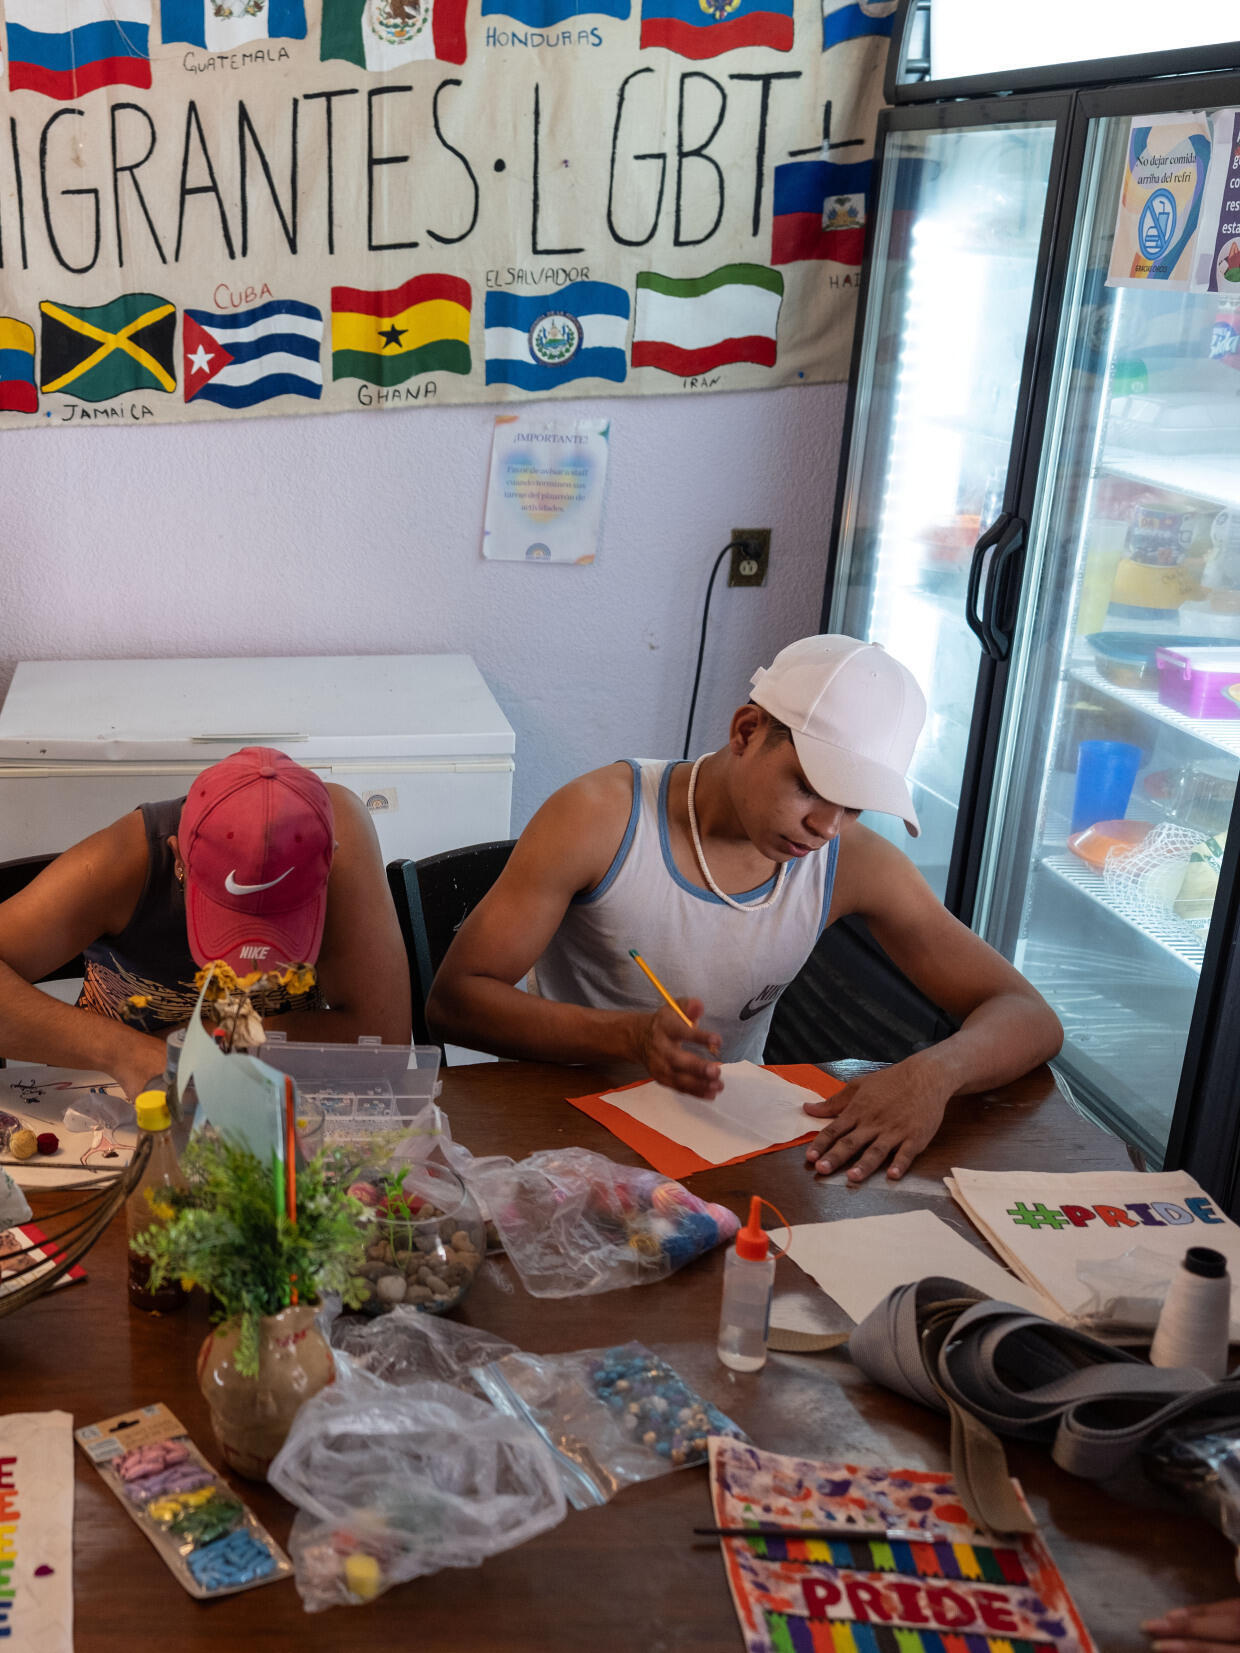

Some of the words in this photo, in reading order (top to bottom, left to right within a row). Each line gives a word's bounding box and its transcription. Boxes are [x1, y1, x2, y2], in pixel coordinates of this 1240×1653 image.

[486, 27, 603, 48] HONDURAS
[183, 47, 290, 72] GUATEMALA
[1137, 156, 1148, 167] No
[1150, 155, 1169, 168] dejar
[1137, 173, 1160, 185] arriba
[1161, 172, 1172, 184] del
[1174, 172, 1192, 183] refri
[829, 273, 862, 289] HAI
[213, 283, 274, 310] CUBA
[683, 376, 721, 390] IRAN
[357, 382, 437, 407] GHANA
[240, 945, 271, 960] NIKE
[1006, 1197, 1226, 1230] #PRIDE
[800, 1577, 1019, 1632] PRIDE
